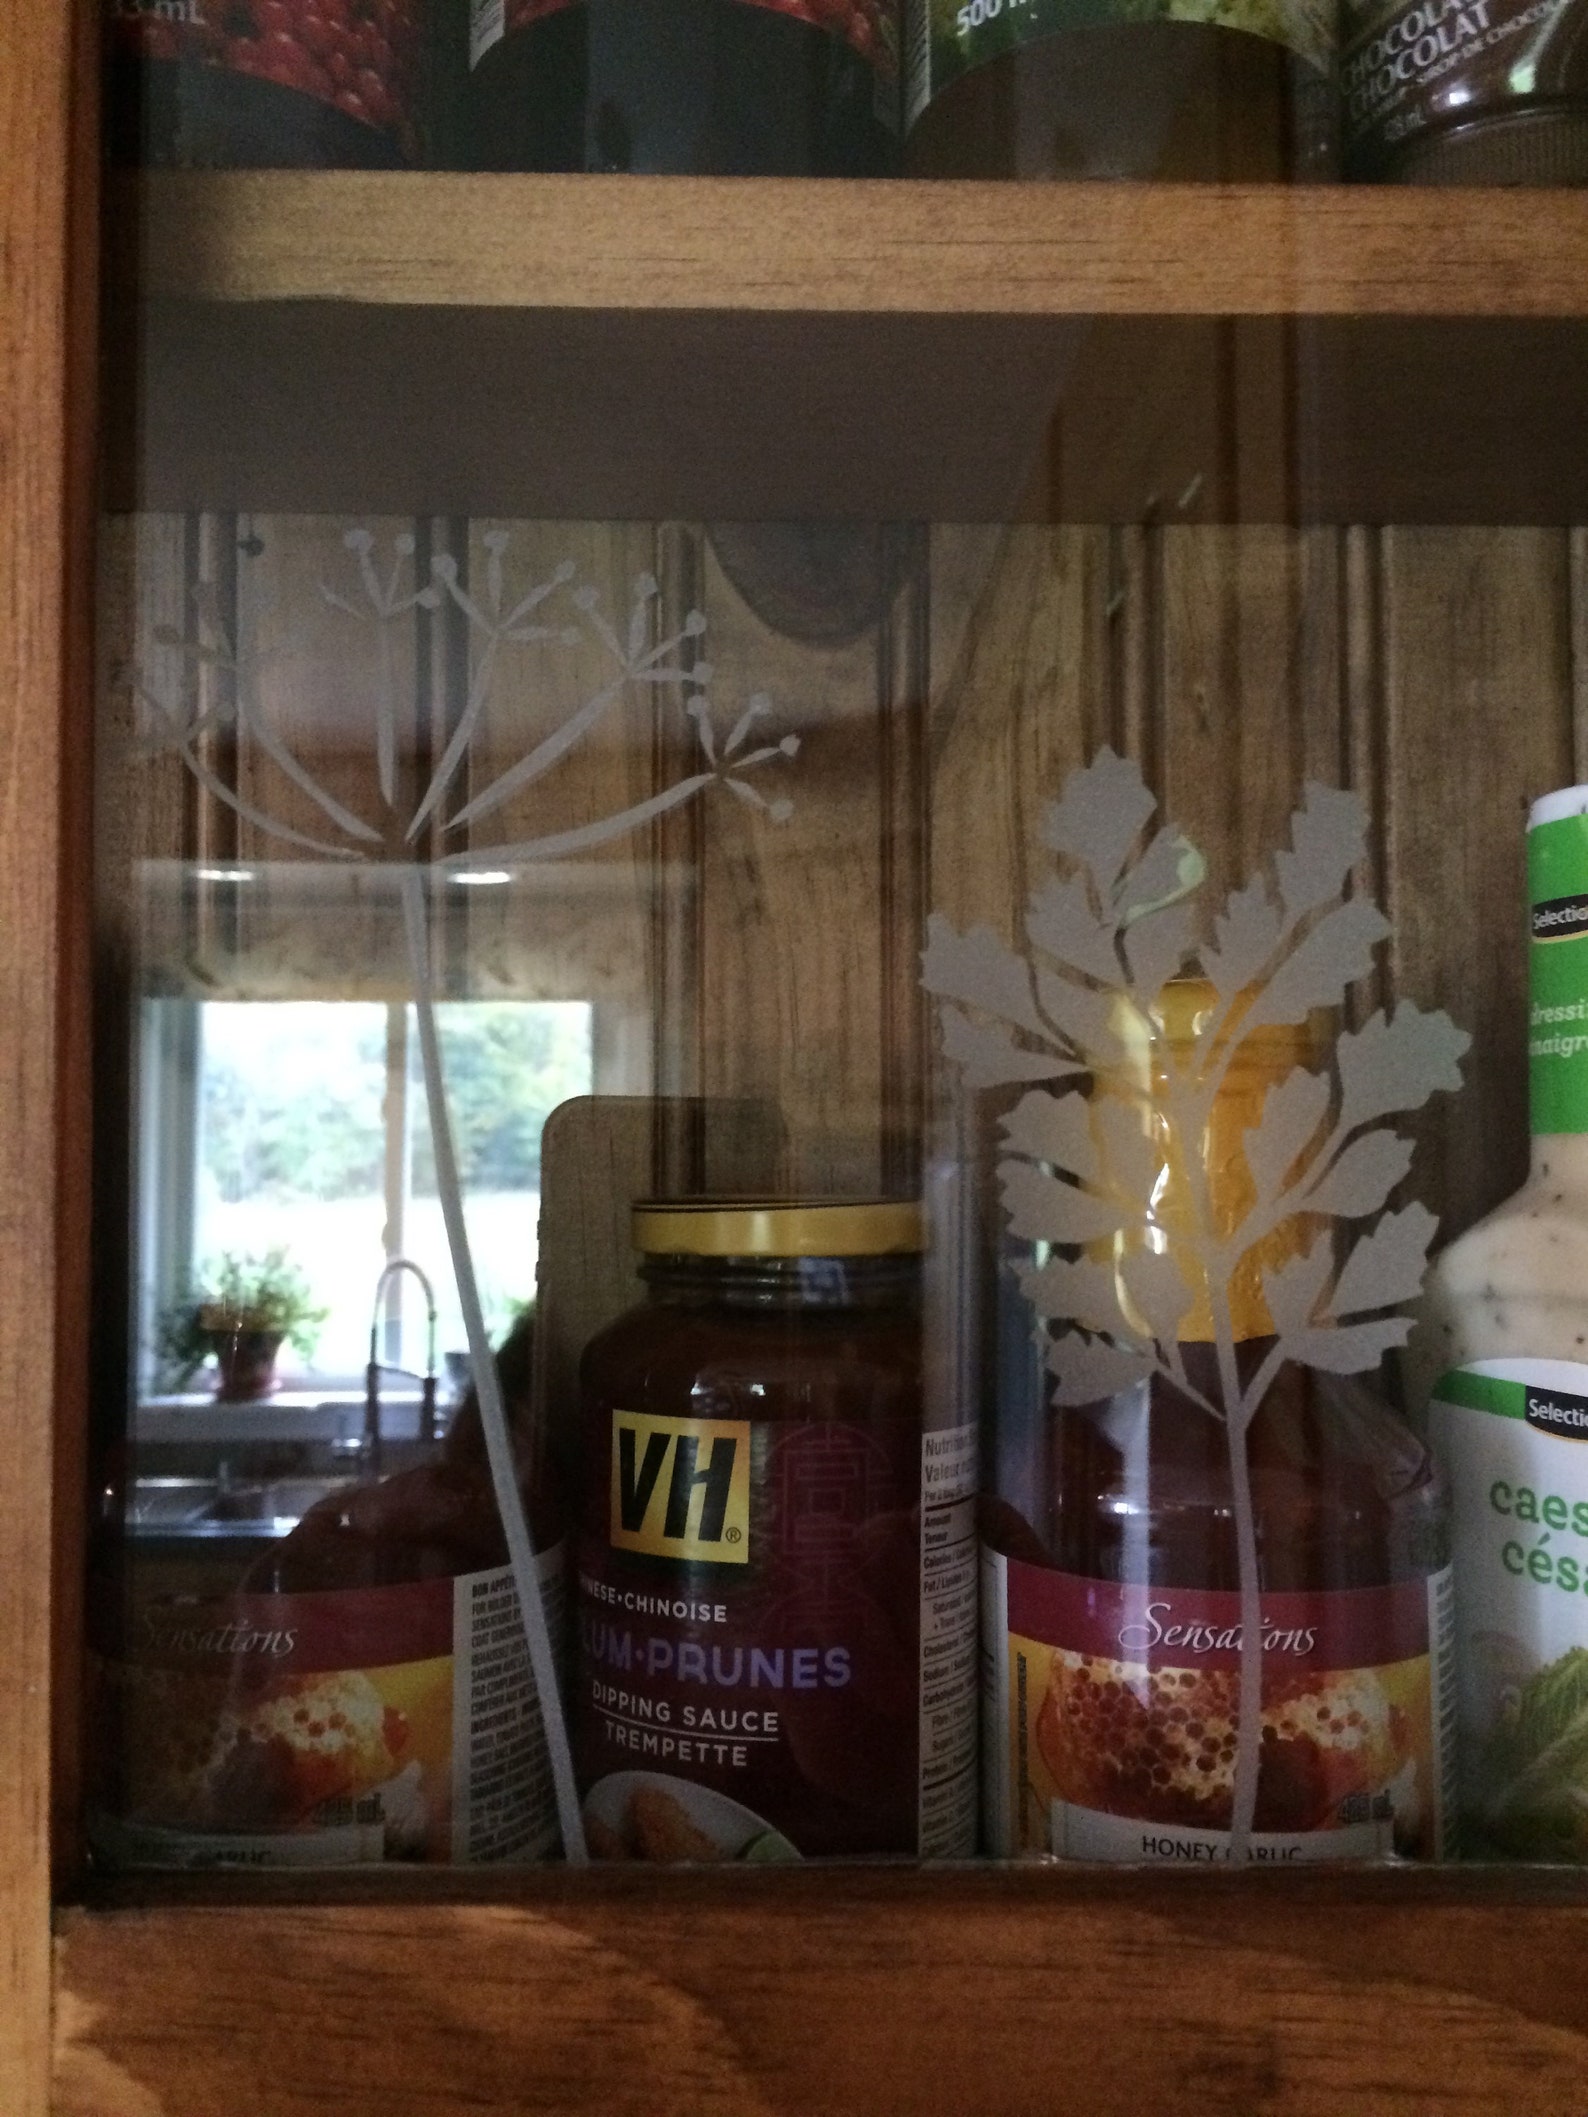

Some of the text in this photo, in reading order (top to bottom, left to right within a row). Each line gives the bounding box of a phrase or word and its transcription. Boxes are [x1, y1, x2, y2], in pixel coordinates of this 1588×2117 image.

[1533, 905, 1588, 930] Selectio
[1118, 1602, 1318, 1656] Sensaons
[592, 1680, 779, 1733] DIPPING SAUCE
[605, 1720, 747, 1767] TREMPETTE
[1142, 1835, 1217, 1861] HONEY
